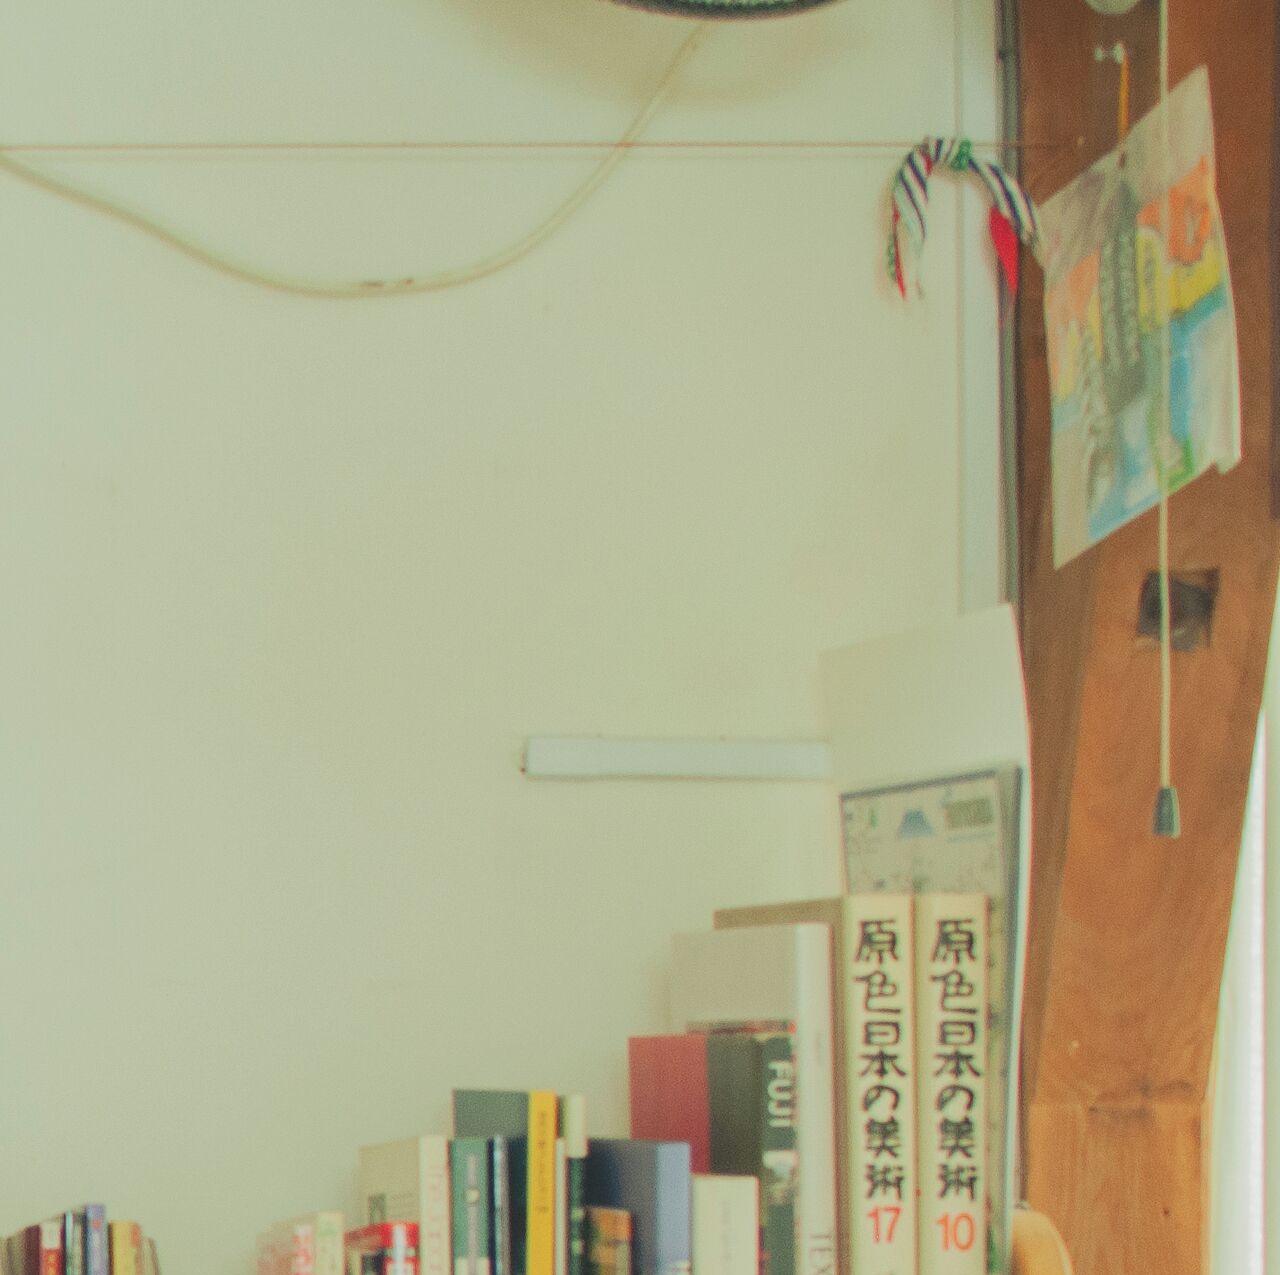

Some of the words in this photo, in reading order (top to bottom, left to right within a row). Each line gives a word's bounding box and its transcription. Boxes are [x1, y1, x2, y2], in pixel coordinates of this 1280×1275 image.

[852, 917, 907, 1201] 原色日本の美術
[929, 917, 982, 1202] 原色日本の美術
[867, 1206, 902, 1244] 17
[936, 1212, 977, 1252] 10
